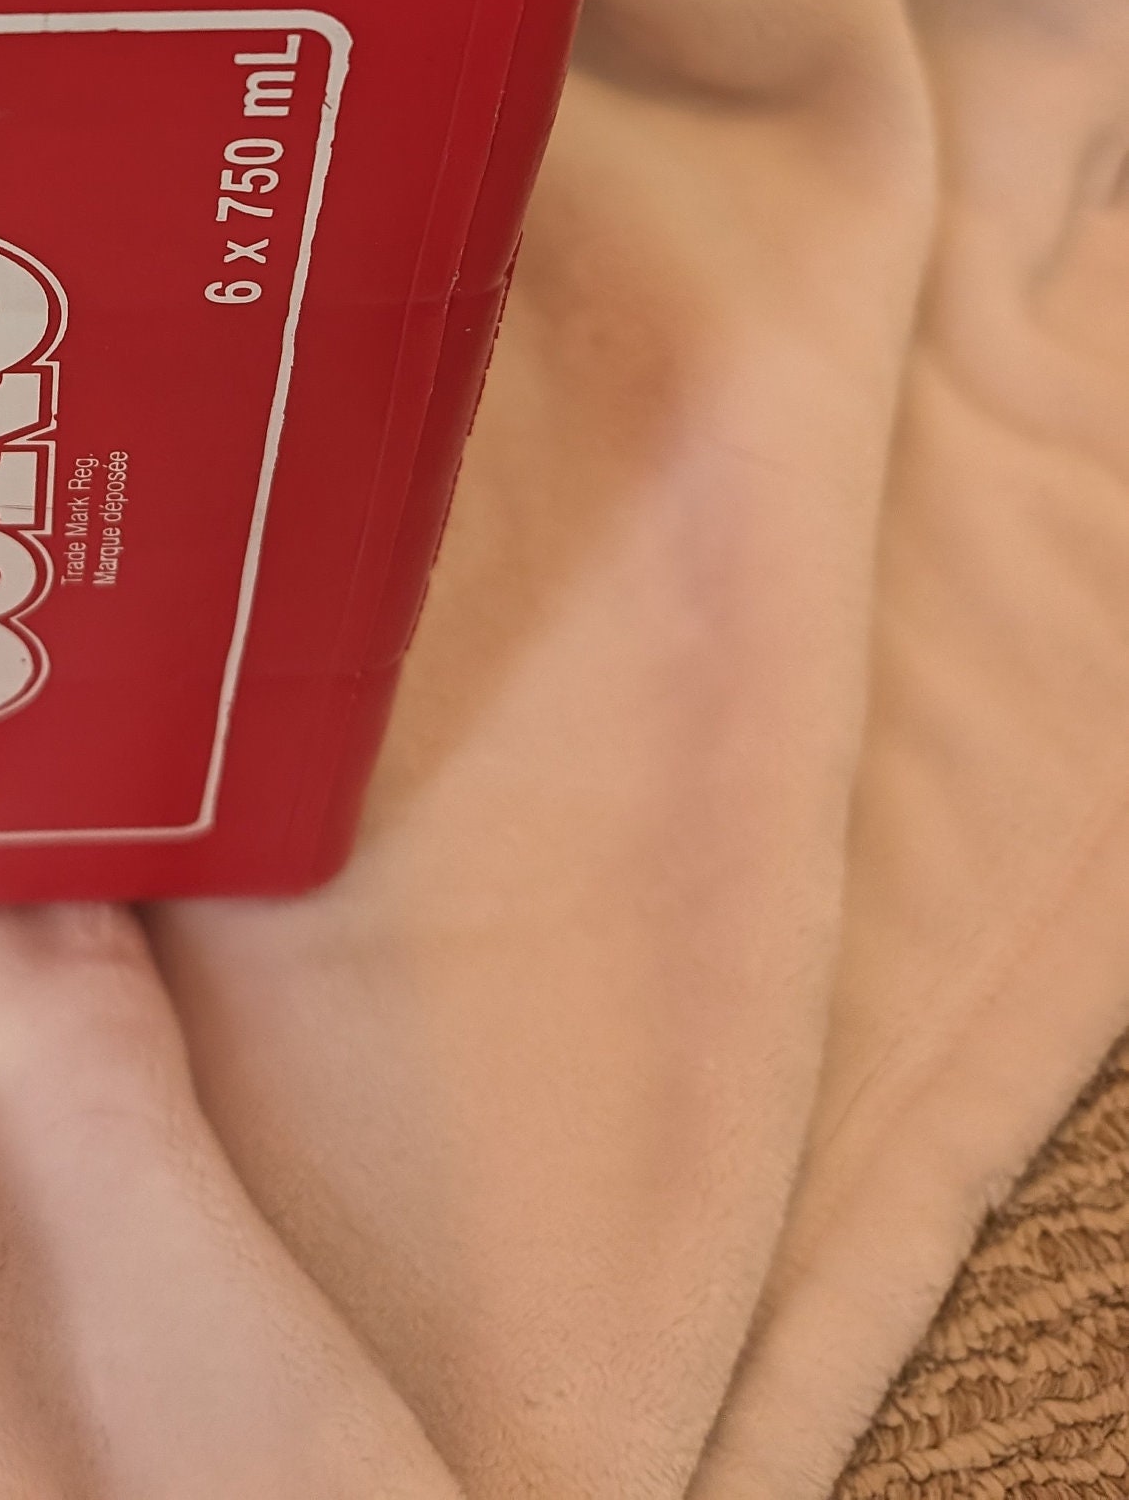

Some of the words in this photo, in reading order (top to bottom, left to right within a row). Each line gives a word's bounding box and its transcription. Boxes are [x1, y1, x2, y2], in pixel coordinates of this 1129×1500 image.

[234, 34, 302, 117] mL
[216, 138, 284, 222] 750
[223, 238, 269, 263] x
[204, 280, 262, 304] 6
[68, 453, 99, 490] Reg.
[98, 451, 129, 522] déposée
[64, 496, 90, 537] Mark
[60, 542, 87, 586] Trade
[92, 527, 124, 586] Marque
